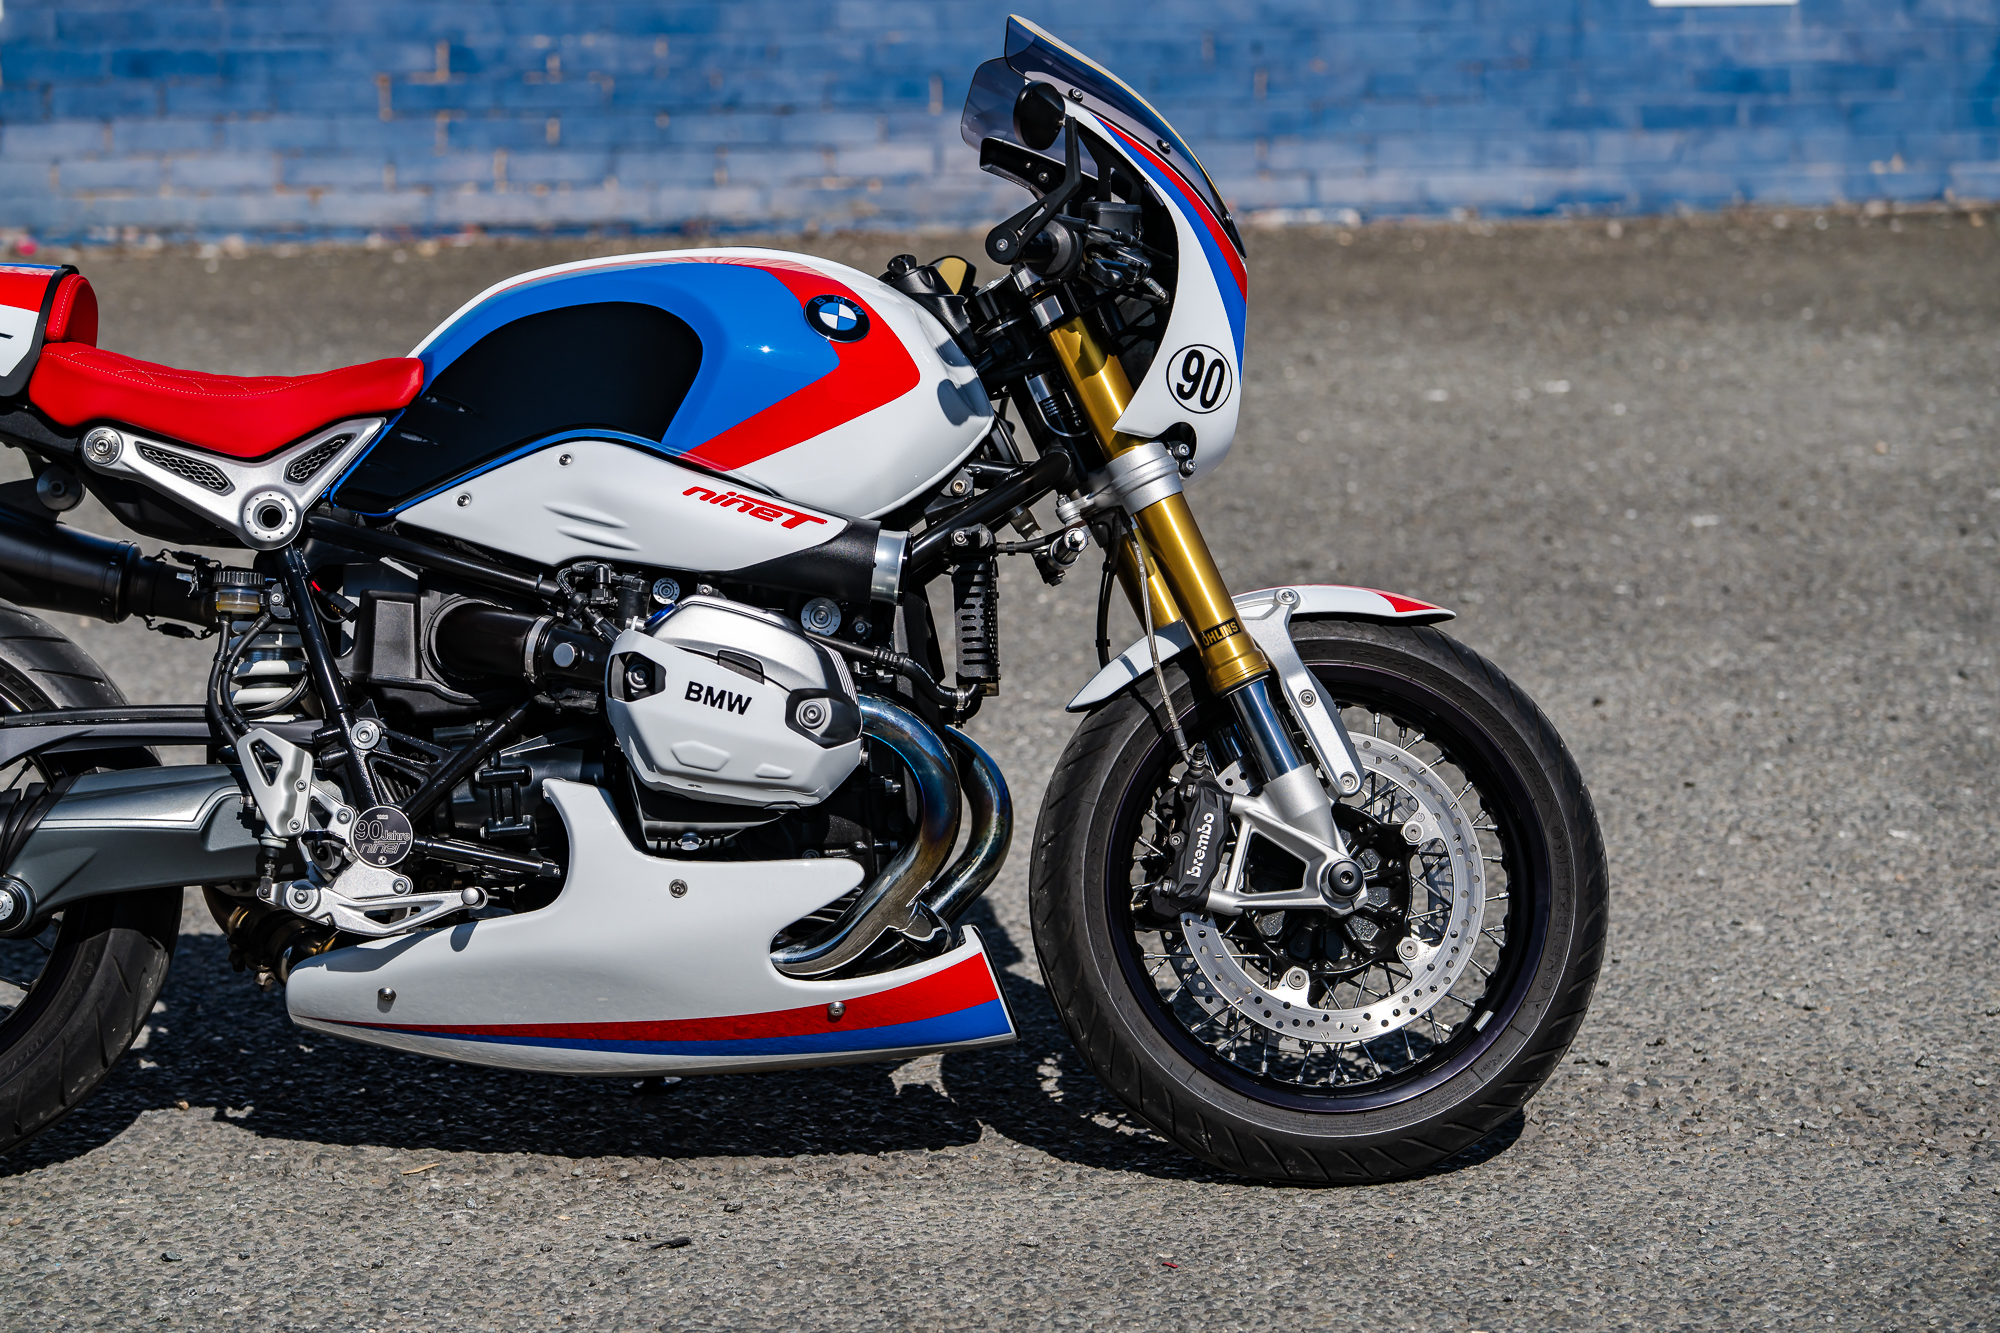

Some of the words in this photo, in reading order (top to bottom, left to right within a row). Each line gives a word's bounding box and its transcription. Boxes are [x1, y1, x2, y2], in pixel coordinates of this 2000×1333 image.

[812, 296, 866, 316] BMW
[1176, 349, 1225, 409] 90
[684, 681, 752, 715] BMW
[355, 820, 383, 840] 90
[381, 829, 411, 841] Jahre
[1186, 813, 1215, 878] brembo
